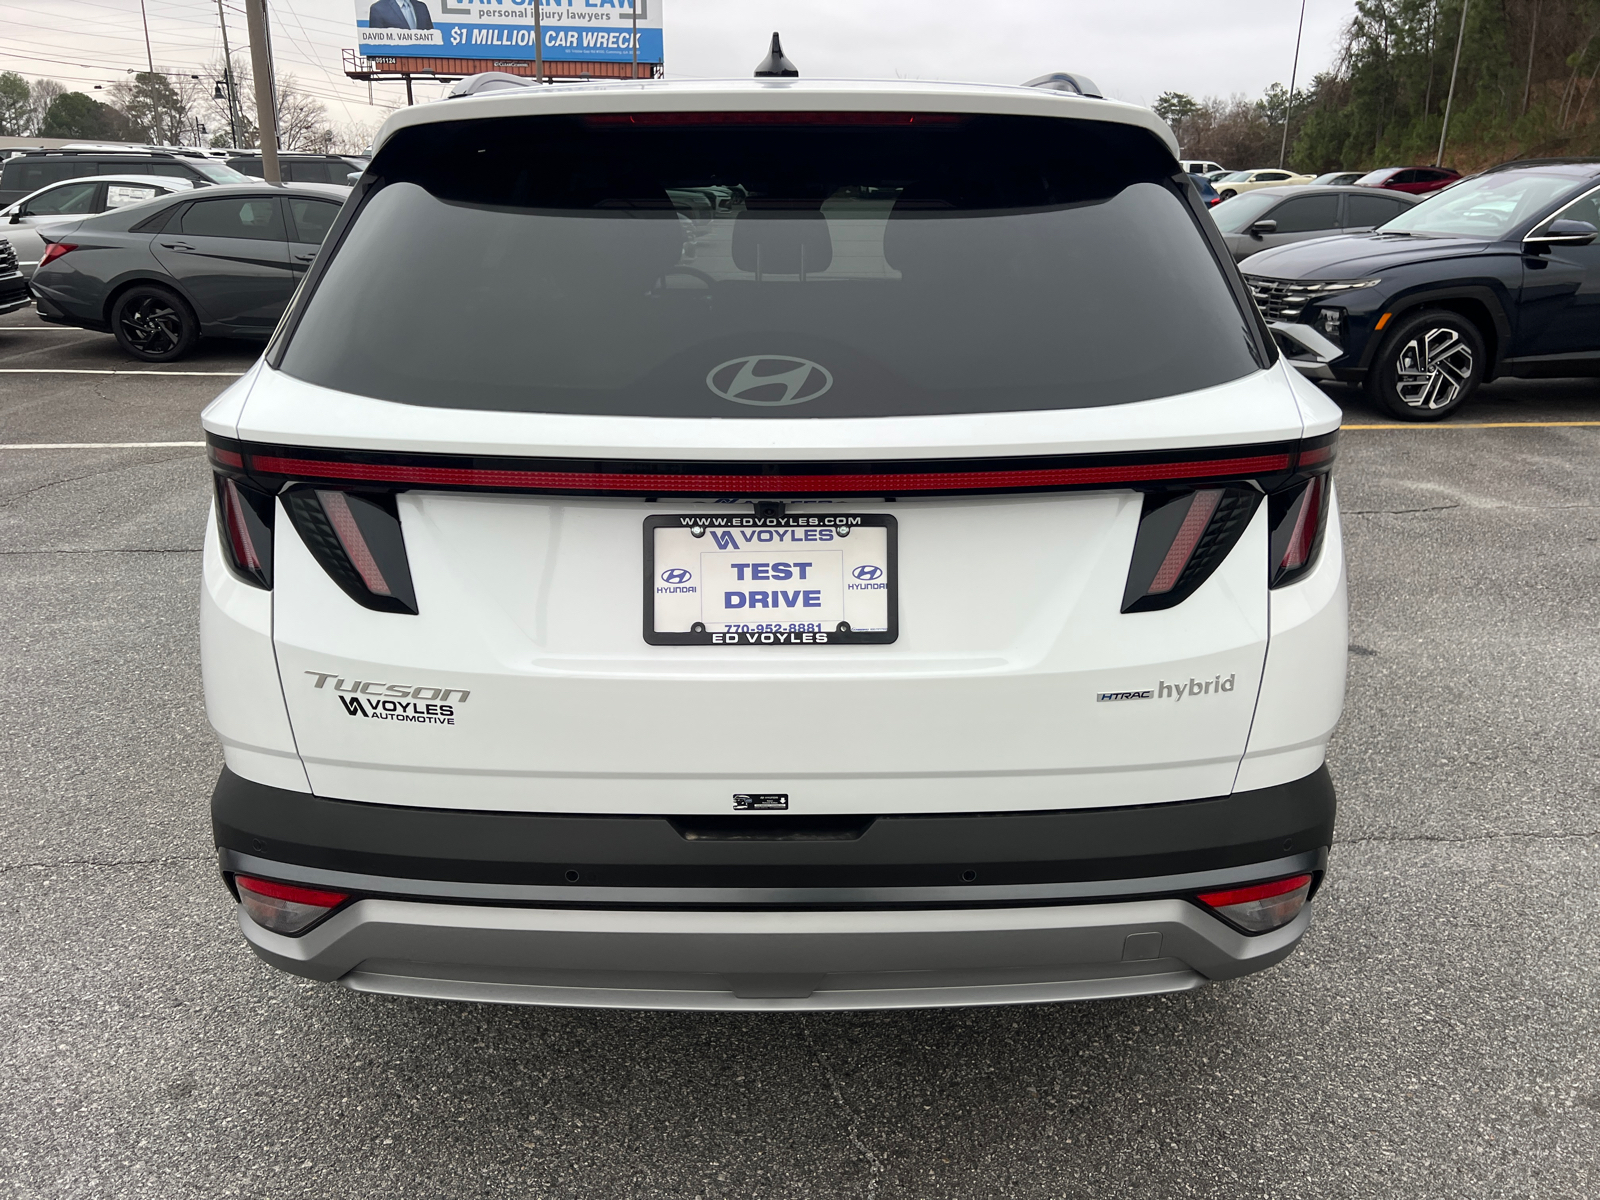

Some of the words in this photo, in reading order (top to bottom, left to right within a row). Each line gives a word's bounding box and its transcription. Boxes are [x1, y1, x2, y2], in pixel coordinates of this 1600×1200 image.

[479, 7, 528, 19] personal
[530, 8, 563, 22] ijury
[566, 9, 611, 23] lawyers
[362, 32, 385, 41] DAVID
[386, 33, 395, 41] M.
[398, 33, 413, 41] VAN
[414, 33, 434, 42] SANT
[450, 26, 468, 46] $1
[544, 30, 579, 47] CAR
[582, 31, 641, 49] WRECK
[680, 517, 862, 526] WWW.EDVOYLES.COM
[740, 529, 834, 543] VOYLES
[731, 562, 813, 581] TEST
[656, 586, 697, 594] HYUNDAI
[724, 590, 822, 609] DRIVE
[724, 622, 822, 633] 770-952-8881
[712, 633, 739, 643] ED
[745, 633, 828, 643] VOYLES
[1101, 690, 1151, 701] HTRAC
[1157, 672, 1236, 702] hybrid
[366, 698, 454, 717] VOYLES
[370, 712, 455, 725] AUTOMOTIVE
